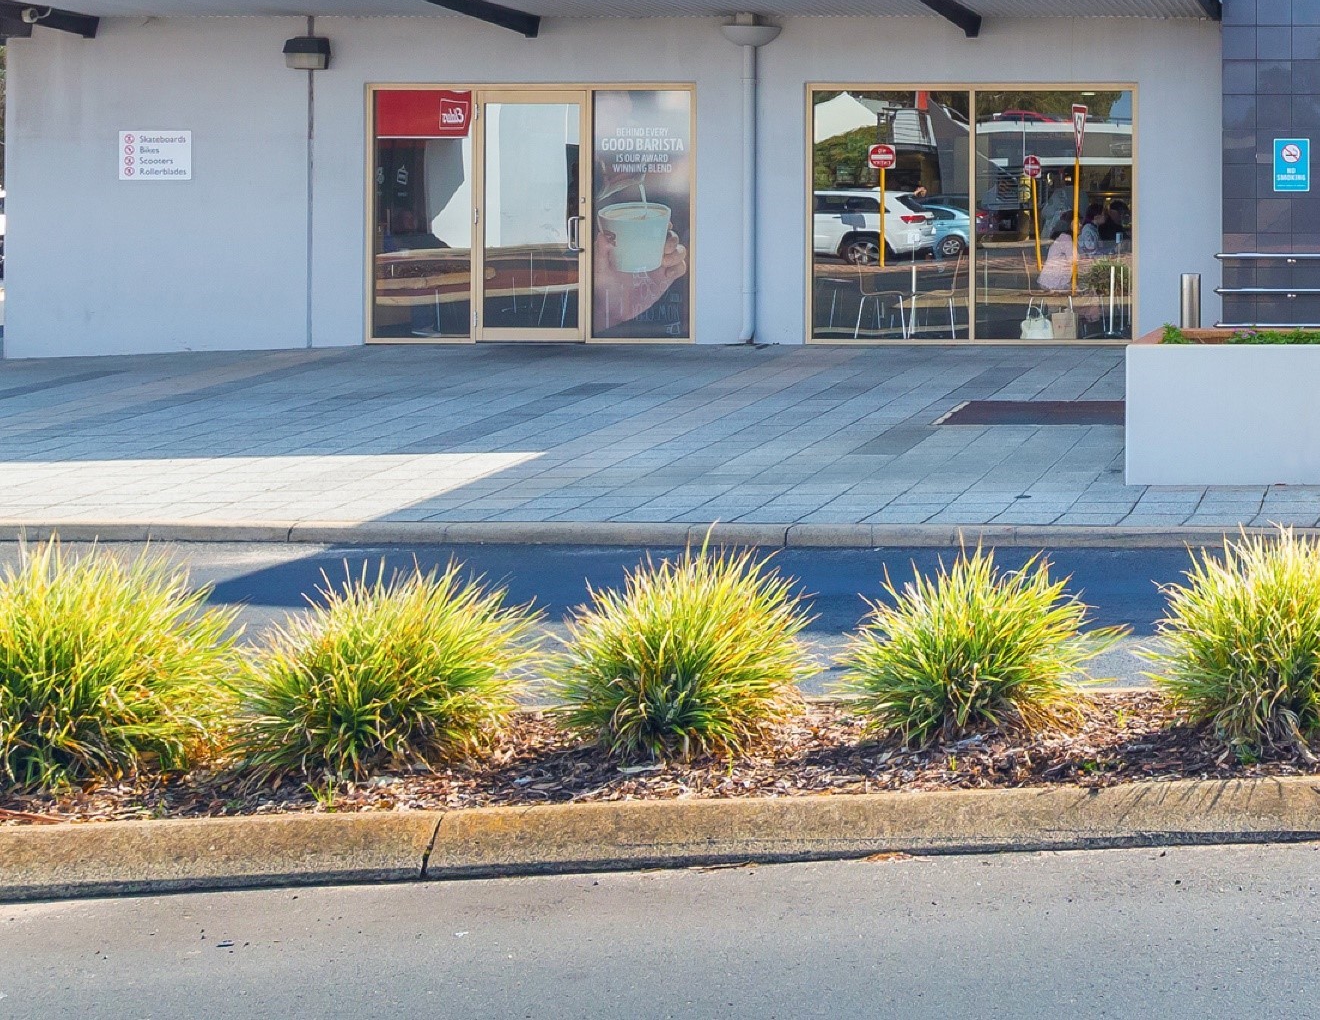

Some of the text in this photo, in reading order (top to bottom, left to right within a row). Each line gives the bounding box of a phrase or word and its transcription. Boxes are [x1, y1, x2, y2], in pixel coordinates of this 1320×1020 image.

[616, 127, 669, 137] BEHIND EVERY
[139, 135, 186, 144] Skateboards
[601, 138, 684, 151] GOOD BARISTA
[139, 146, 160, 154] Bikes
[139, 157, 174, 165] Scooters
[615, 153, 668, 163] IS OUR AWARD
[139, 167, 187, 176] Rollerblades
[612, 163, 672, 173] WINNING BLEND
